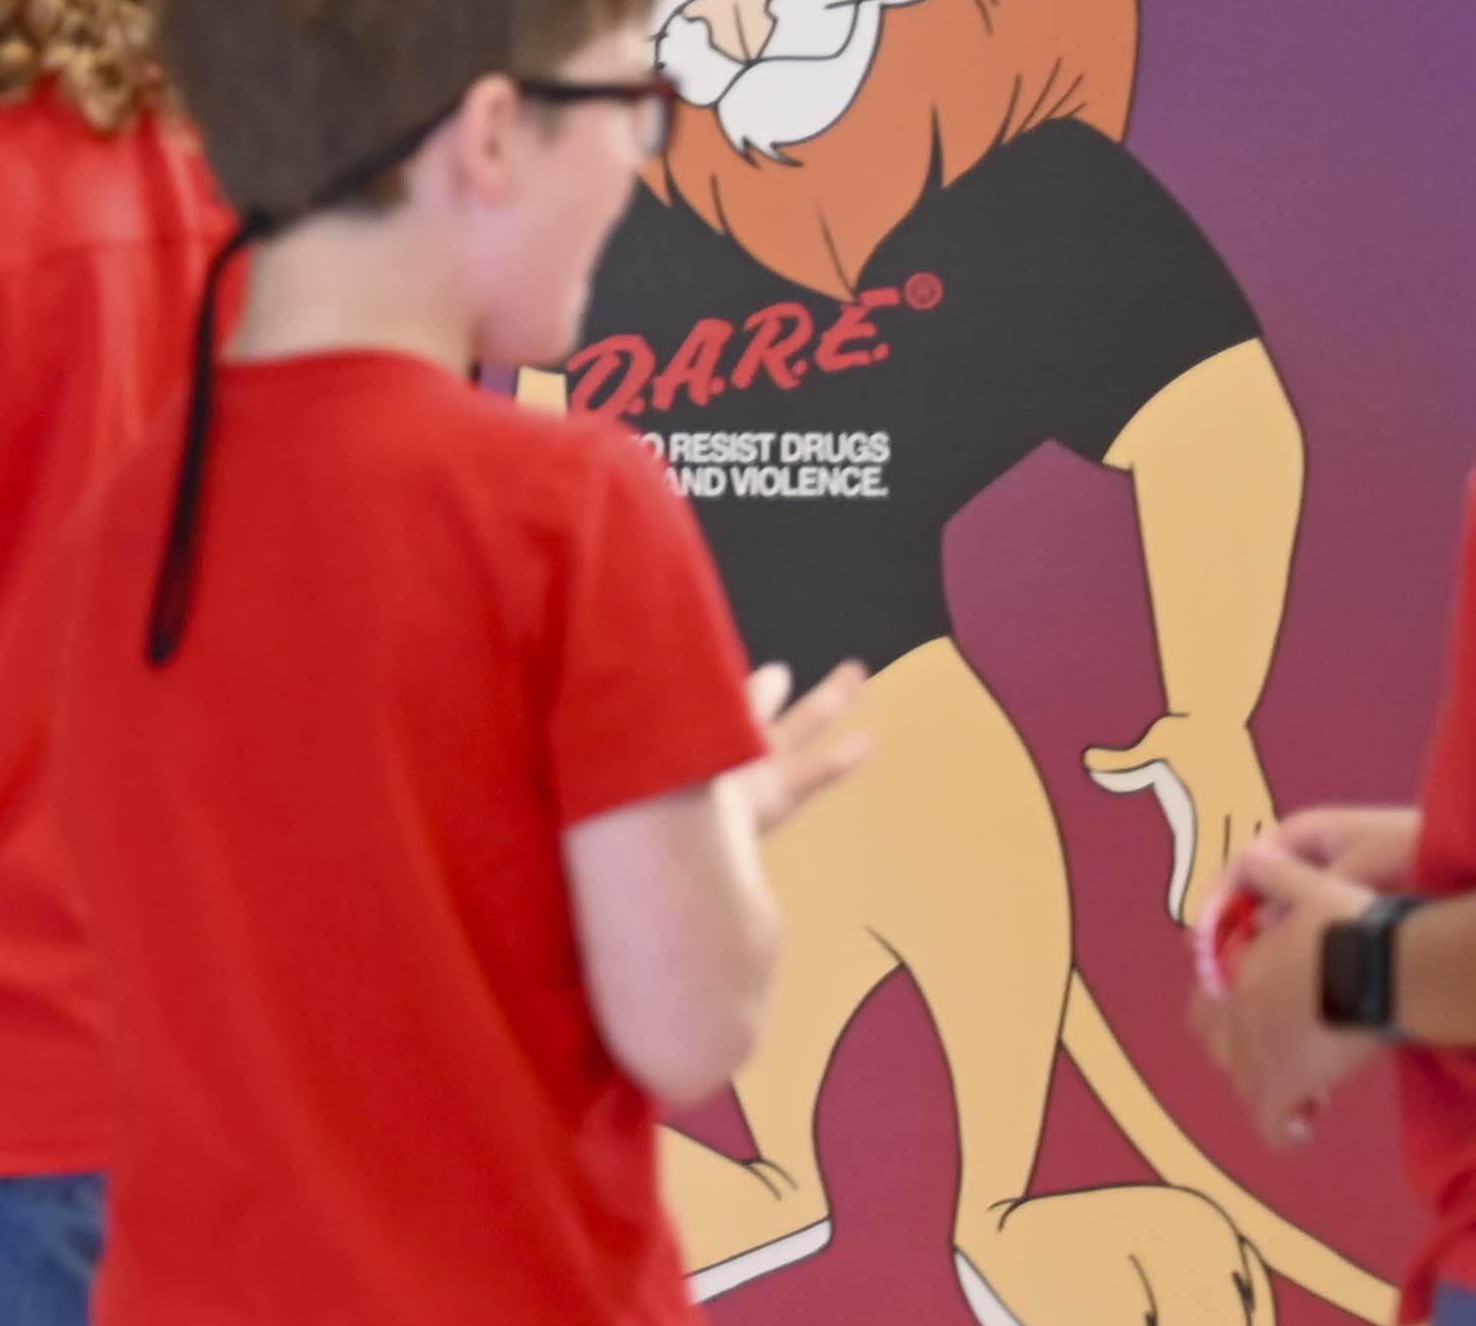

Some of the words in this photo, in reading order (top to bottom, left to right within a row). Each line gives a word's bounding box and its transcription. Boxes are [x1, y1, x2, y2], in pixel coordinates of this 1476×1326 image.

[669, 431, 775, 463] RESIST
[780, 431, 891, 463] DRUGS
[730, 467, 890, 497] VIOLENCE.
